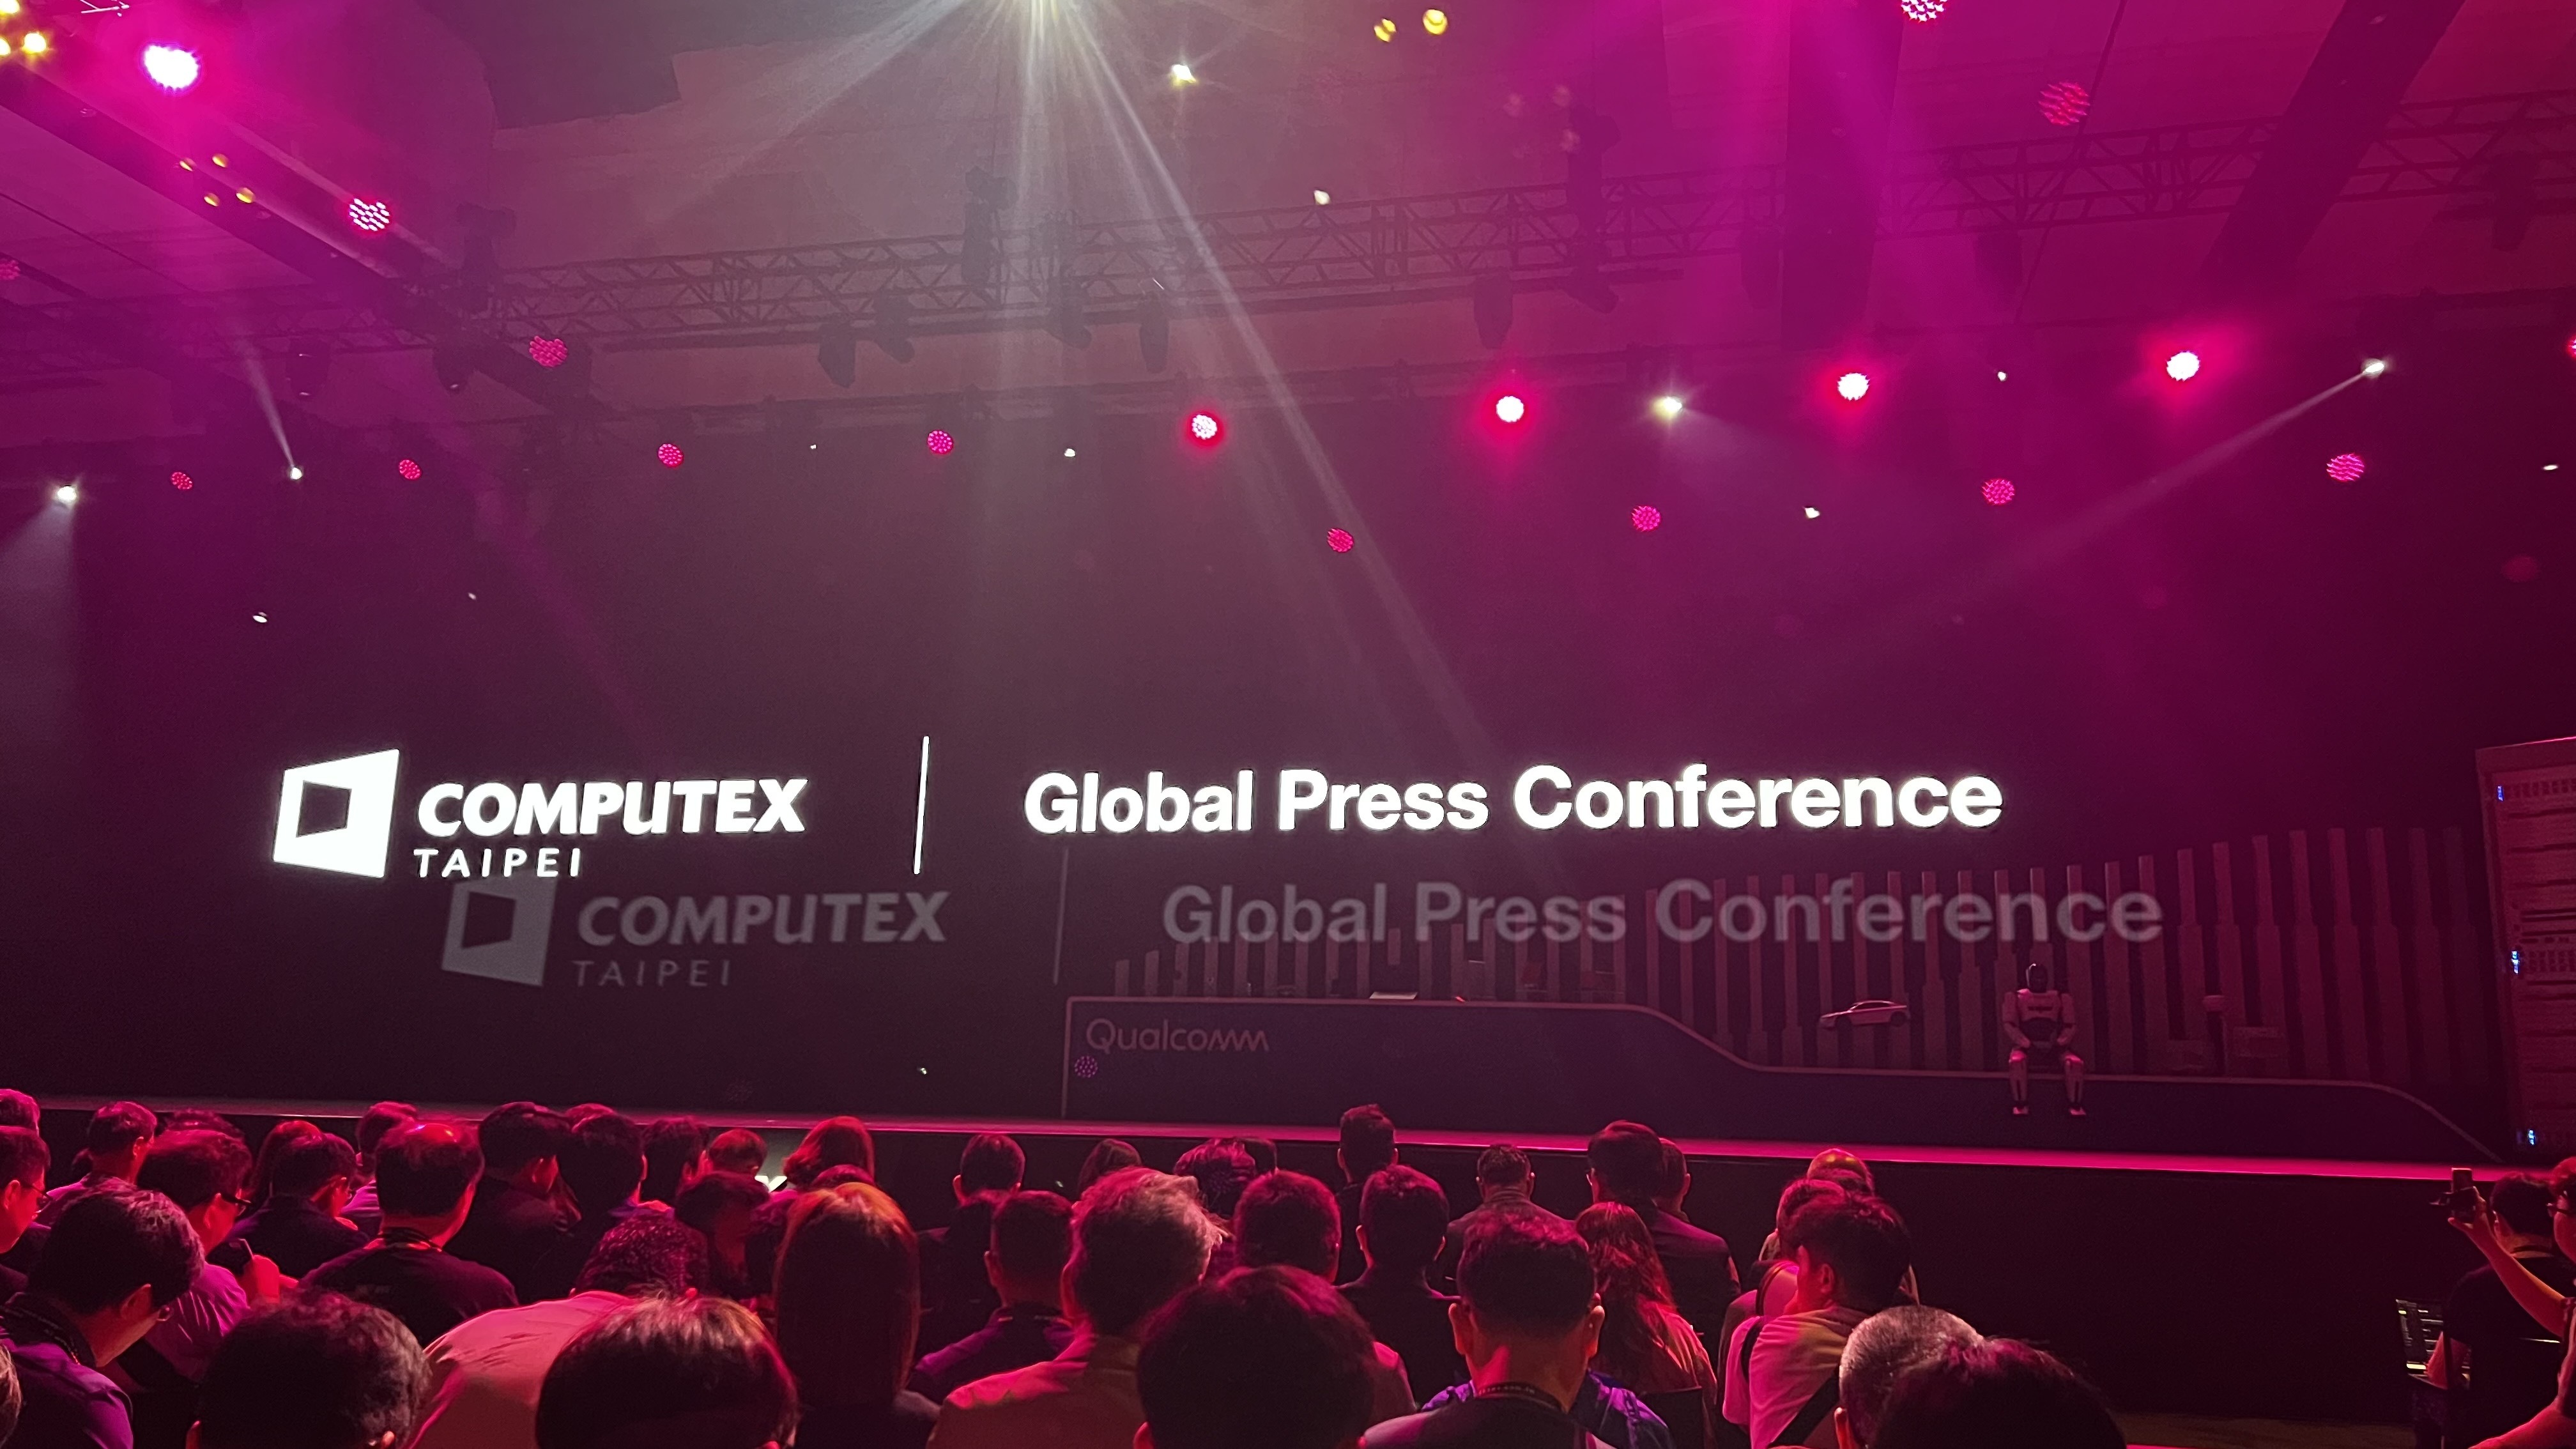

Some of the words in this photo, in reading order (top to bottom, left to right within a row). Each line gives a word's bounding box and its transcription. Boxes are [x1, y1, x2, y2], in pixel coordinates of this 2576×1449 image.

[417, 778, 808, 838] COMPUTEX
[1024, 769, 1254, 834] Global
[1278, 769, 1489, 831] Press
[1512, 763, 2004, 830] Conference
[413, 847, 581, 878] TAIPEI
[578, 891, 949, 945] COMPUTEX
[1163, 883, 1387, 944] Global
[1415, 882, 1626, 942] Press
[1656, 879, 2162, 942] Conference
[572, 960, 730, 987] TAIPEI
[1086, 1018, 1269, 1054] Qualcomm
